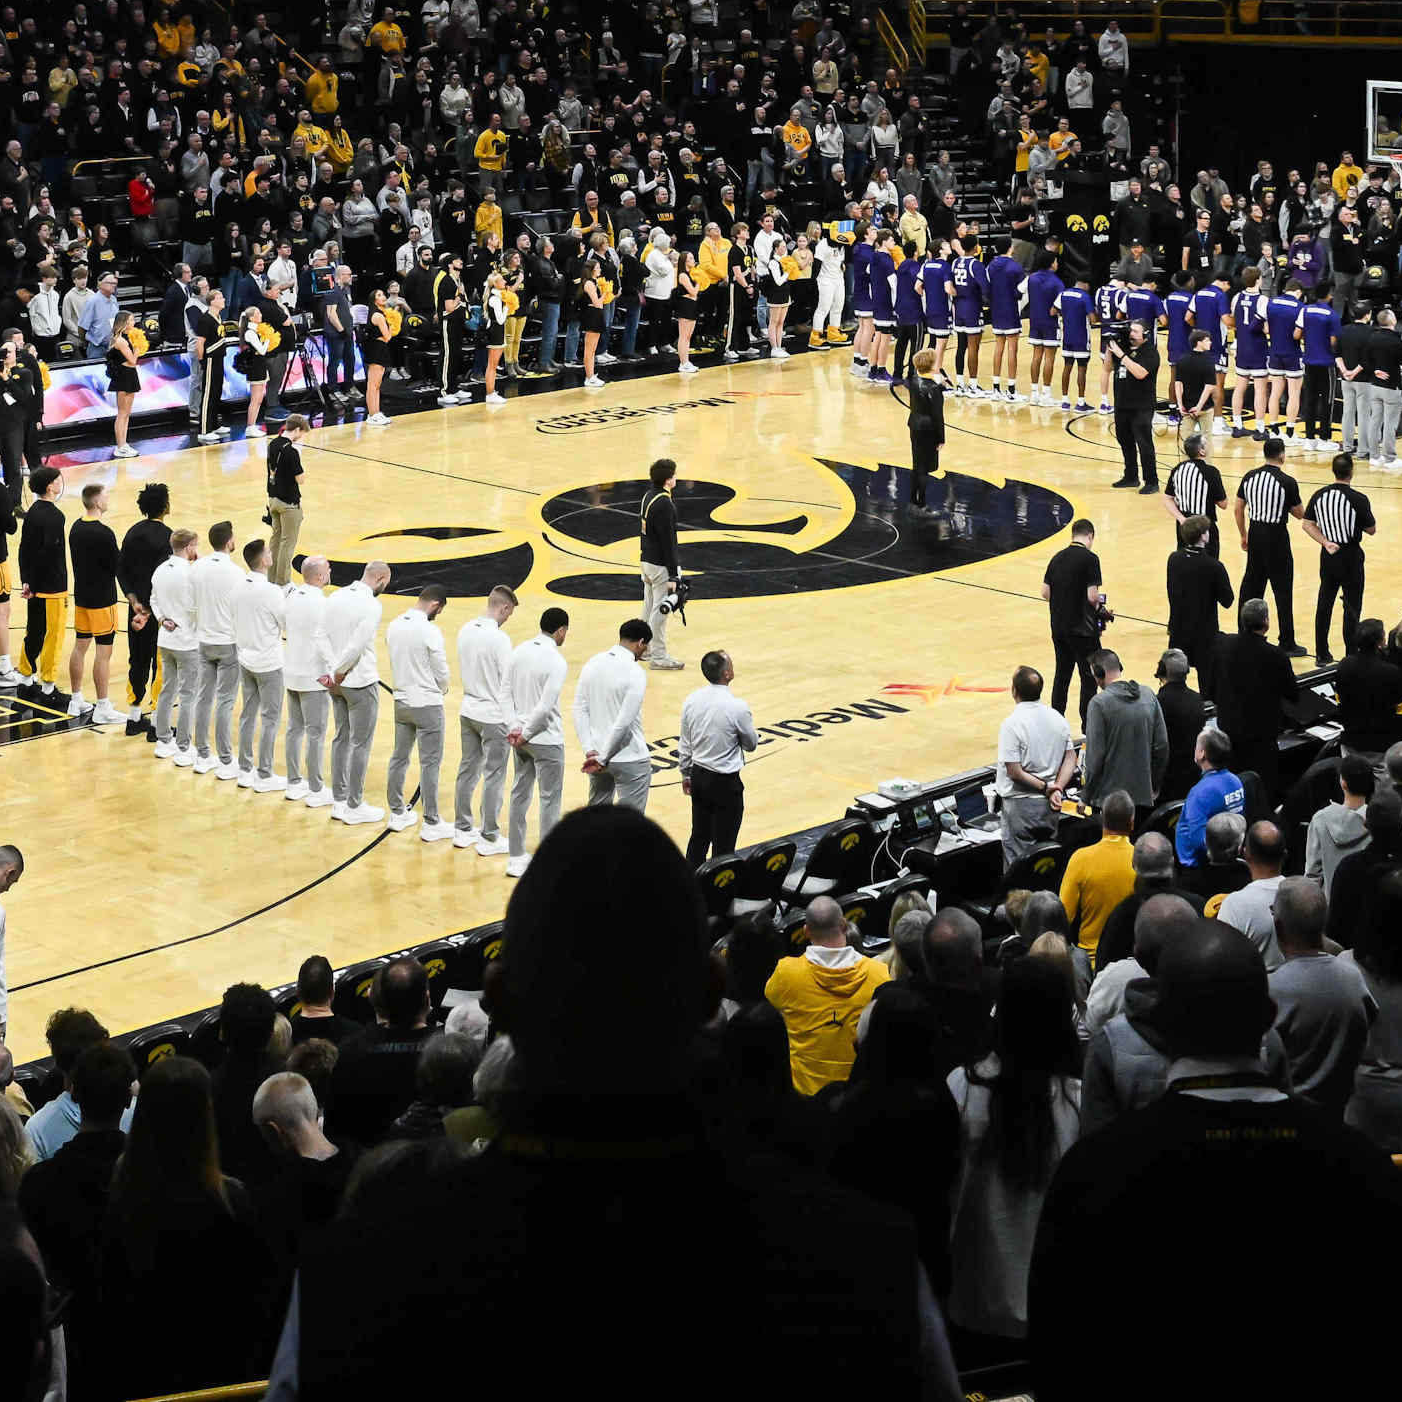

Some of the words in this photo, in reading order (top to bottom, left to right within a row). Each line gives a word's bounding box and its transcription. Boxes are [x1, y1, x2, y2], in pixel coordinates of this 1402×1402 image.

[954, 268, 968, 286] 22
[1102, 301, 1111, 319] 3
[1243, 306, 1250, 324] 1
[1223, 787, 1246, 806] BEST
